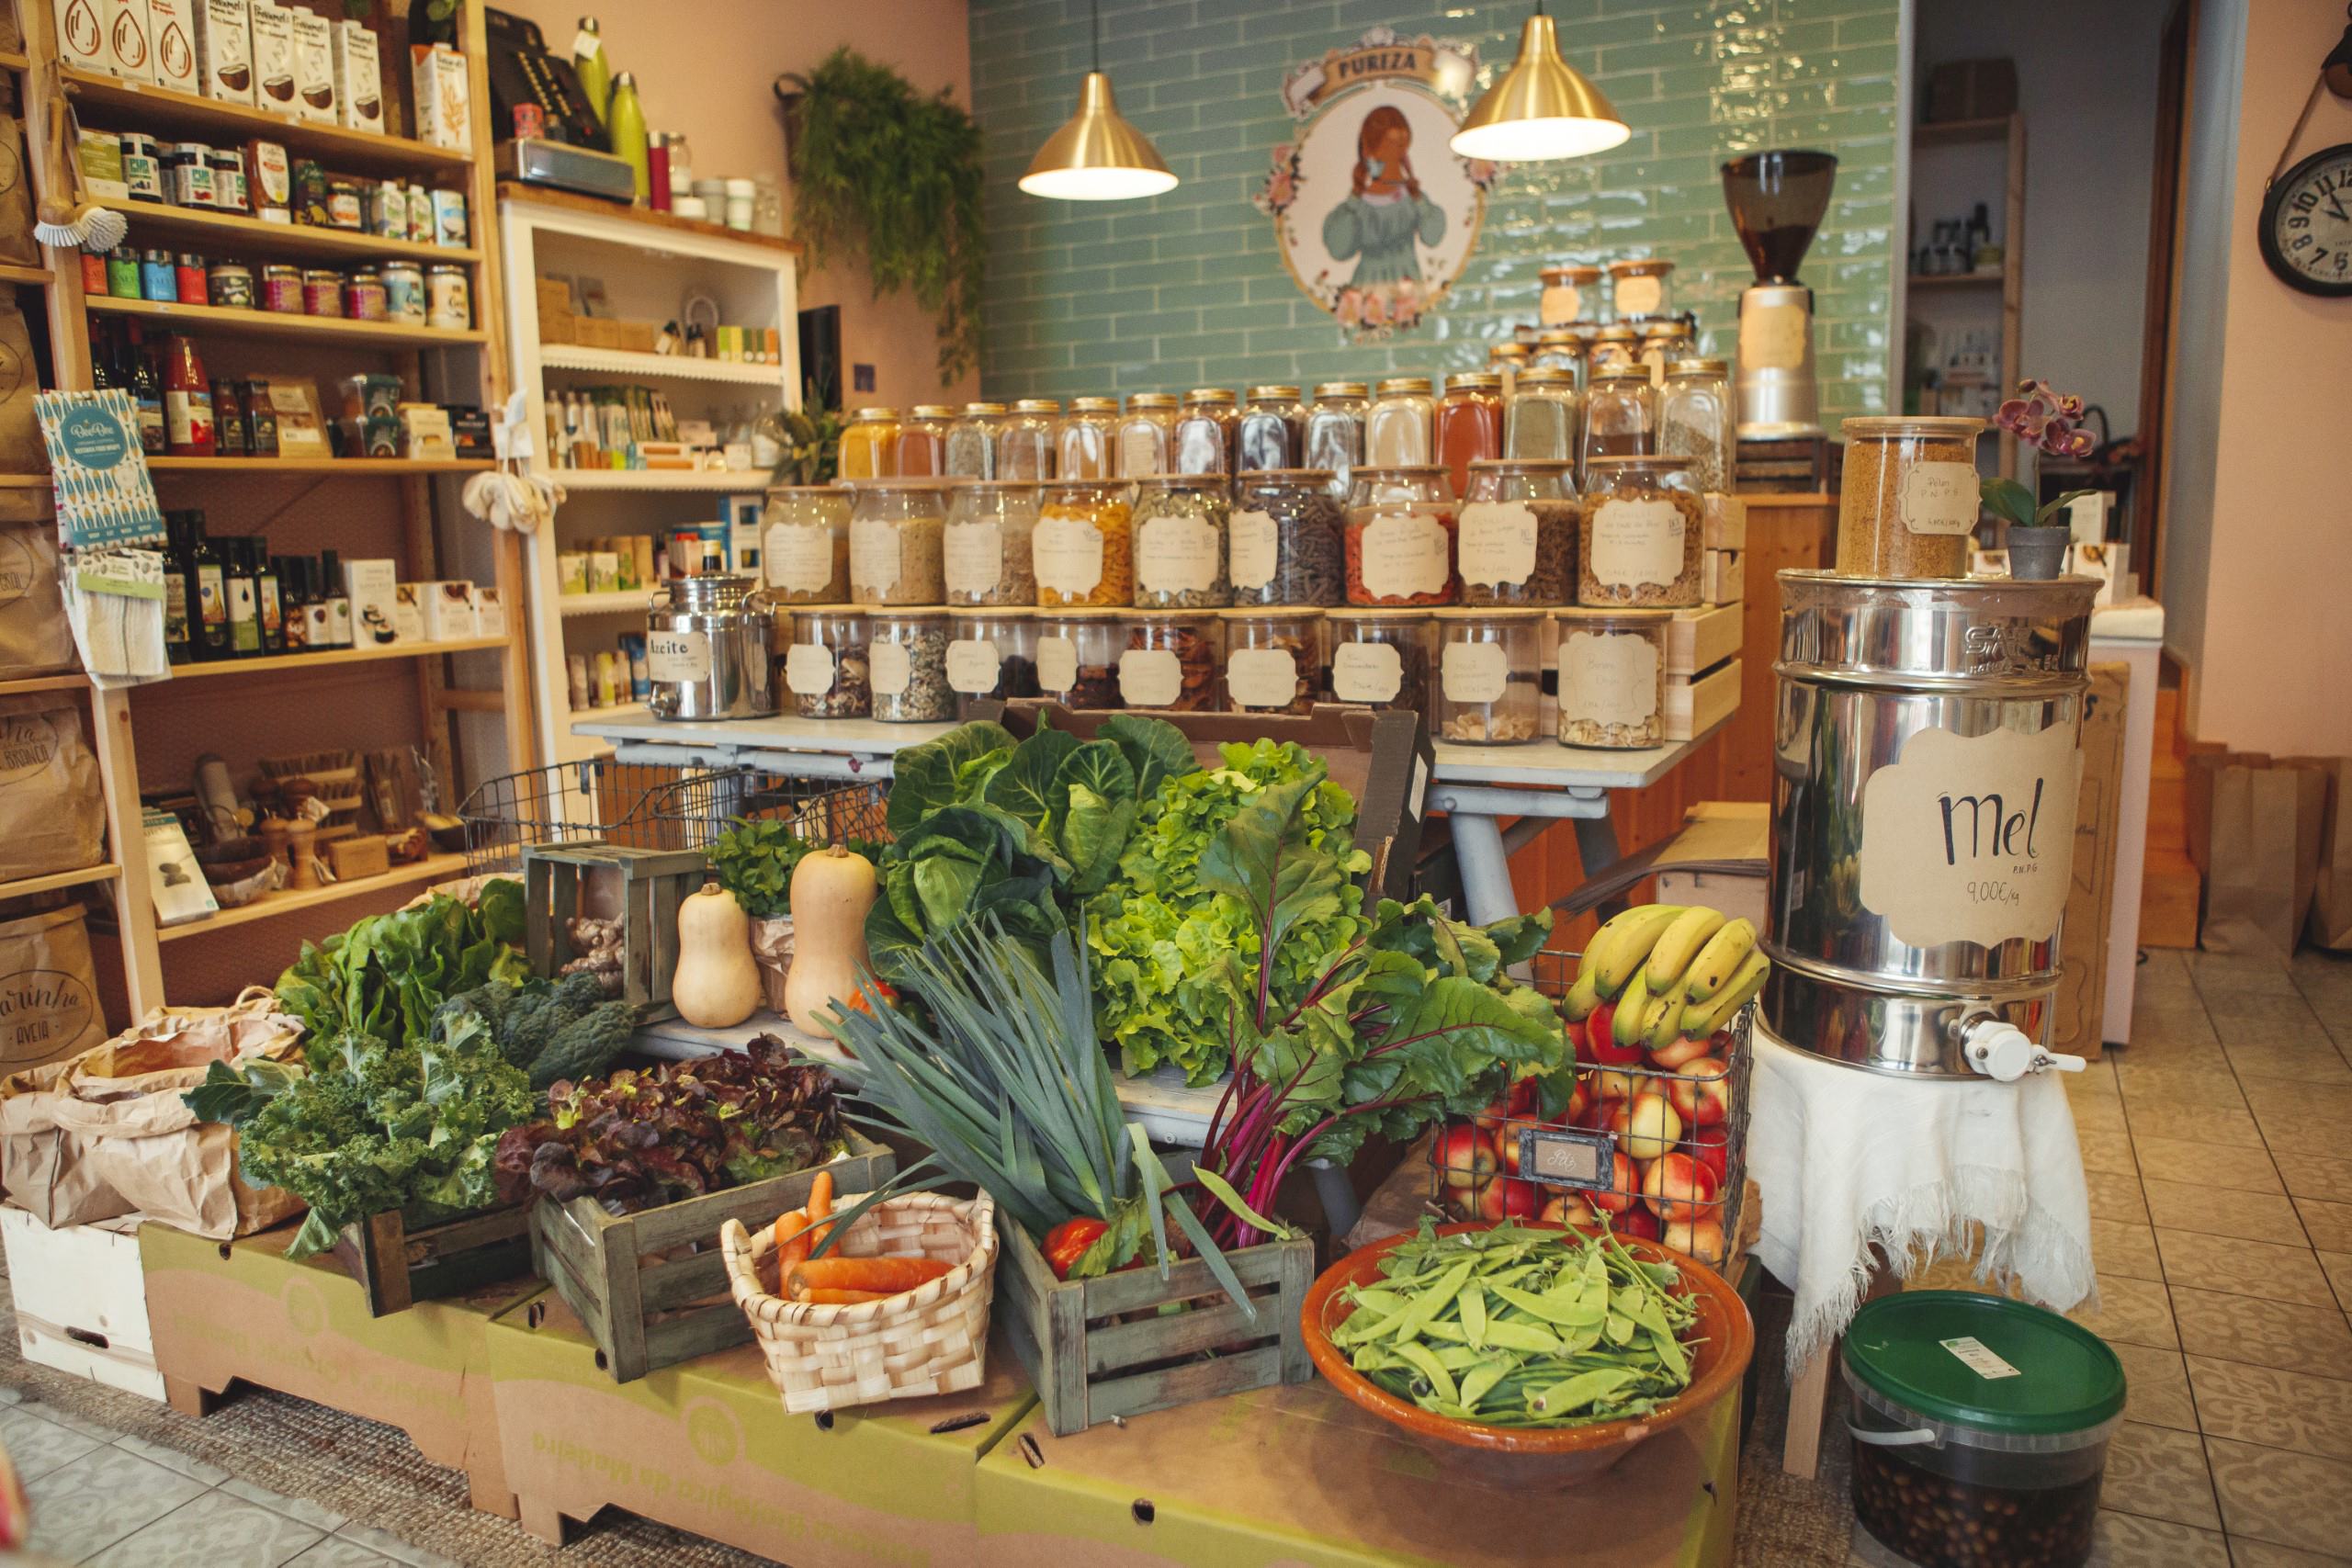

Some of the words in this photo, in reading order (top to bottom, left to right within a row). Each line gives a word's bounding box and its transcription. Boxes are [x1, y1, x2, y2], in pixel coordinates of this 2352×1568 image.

[1339, 51, 1415, 78] PUREZA
[2309, 247, 2328, 265] 7
[650, 638, 689, 655] Azeite
[1937, 777, 2043, 865] Mel
